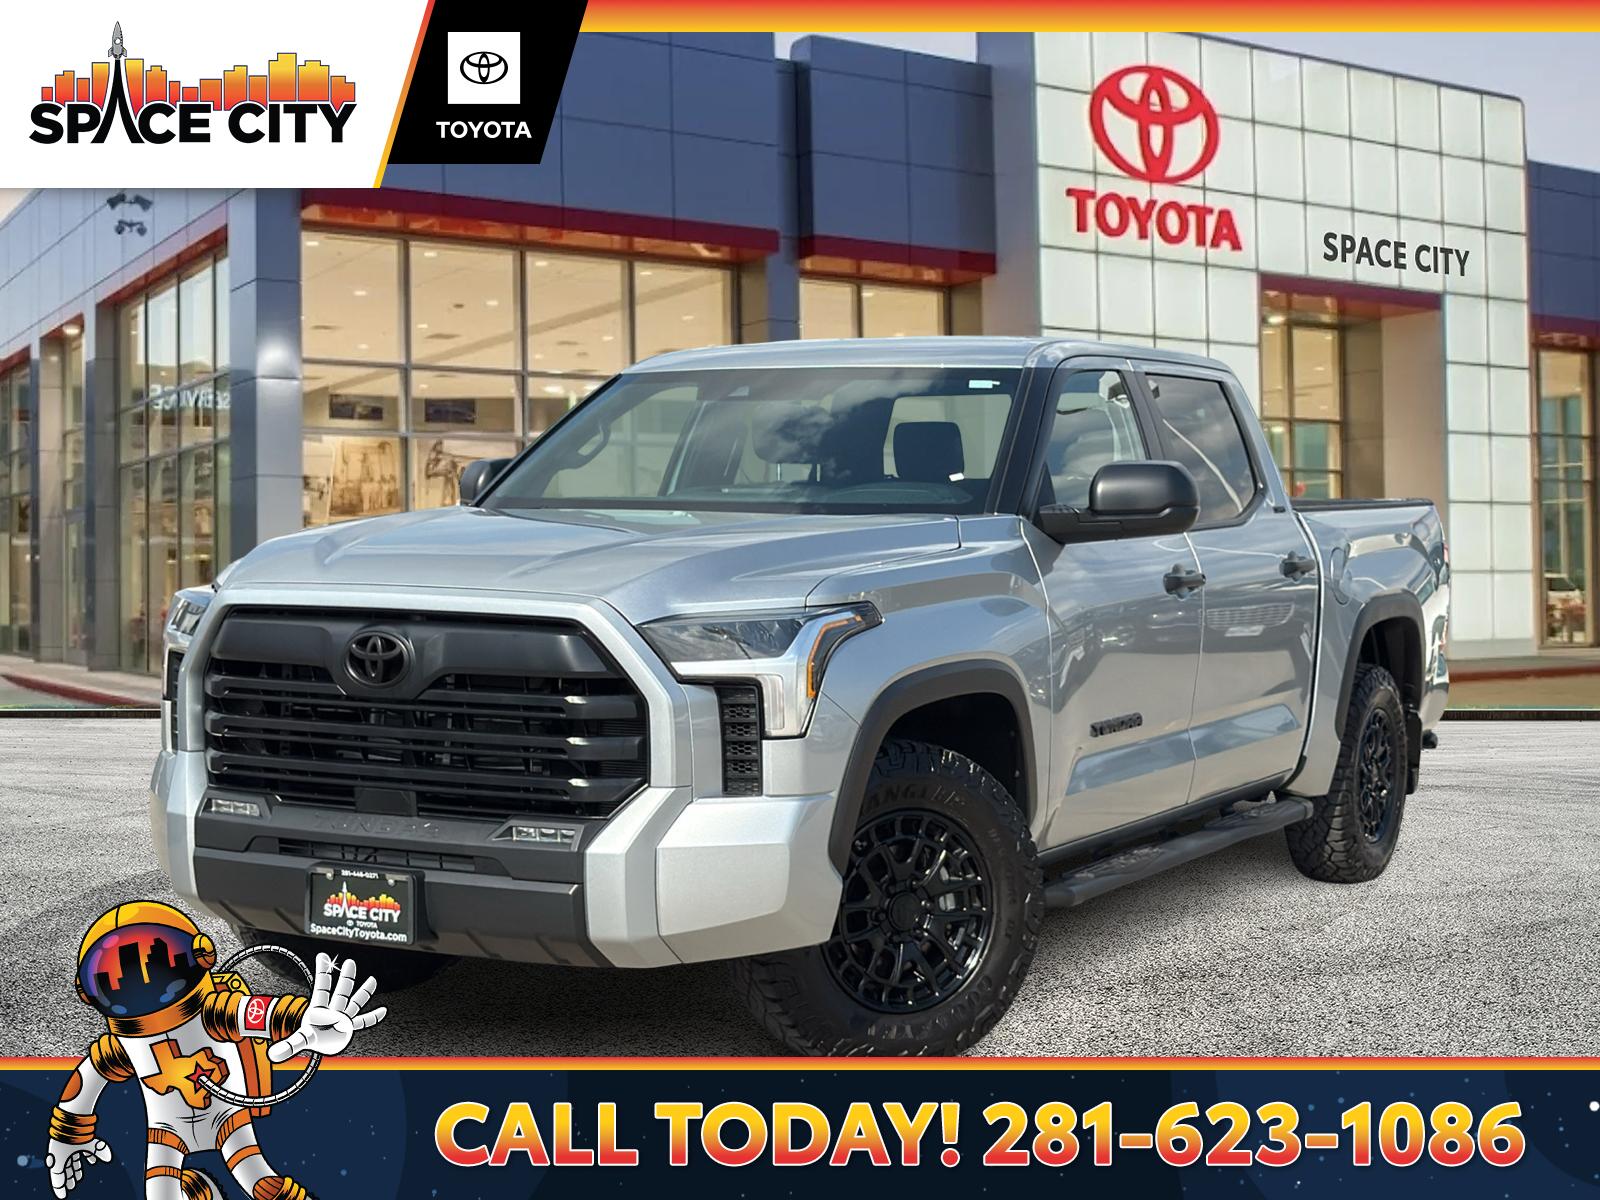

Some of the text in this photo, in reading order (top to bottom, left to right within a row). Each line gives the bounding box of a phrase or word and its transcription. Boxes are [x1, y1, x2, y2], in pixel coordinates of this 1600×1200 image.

[1066, 187, 1243, 251] TOYOTA
[1323, 231, 1470, 276] SPACE CITY
[369, 907, 401, 923] CITY
[310, 923, 407, 942] SpaceCityToyota.com
